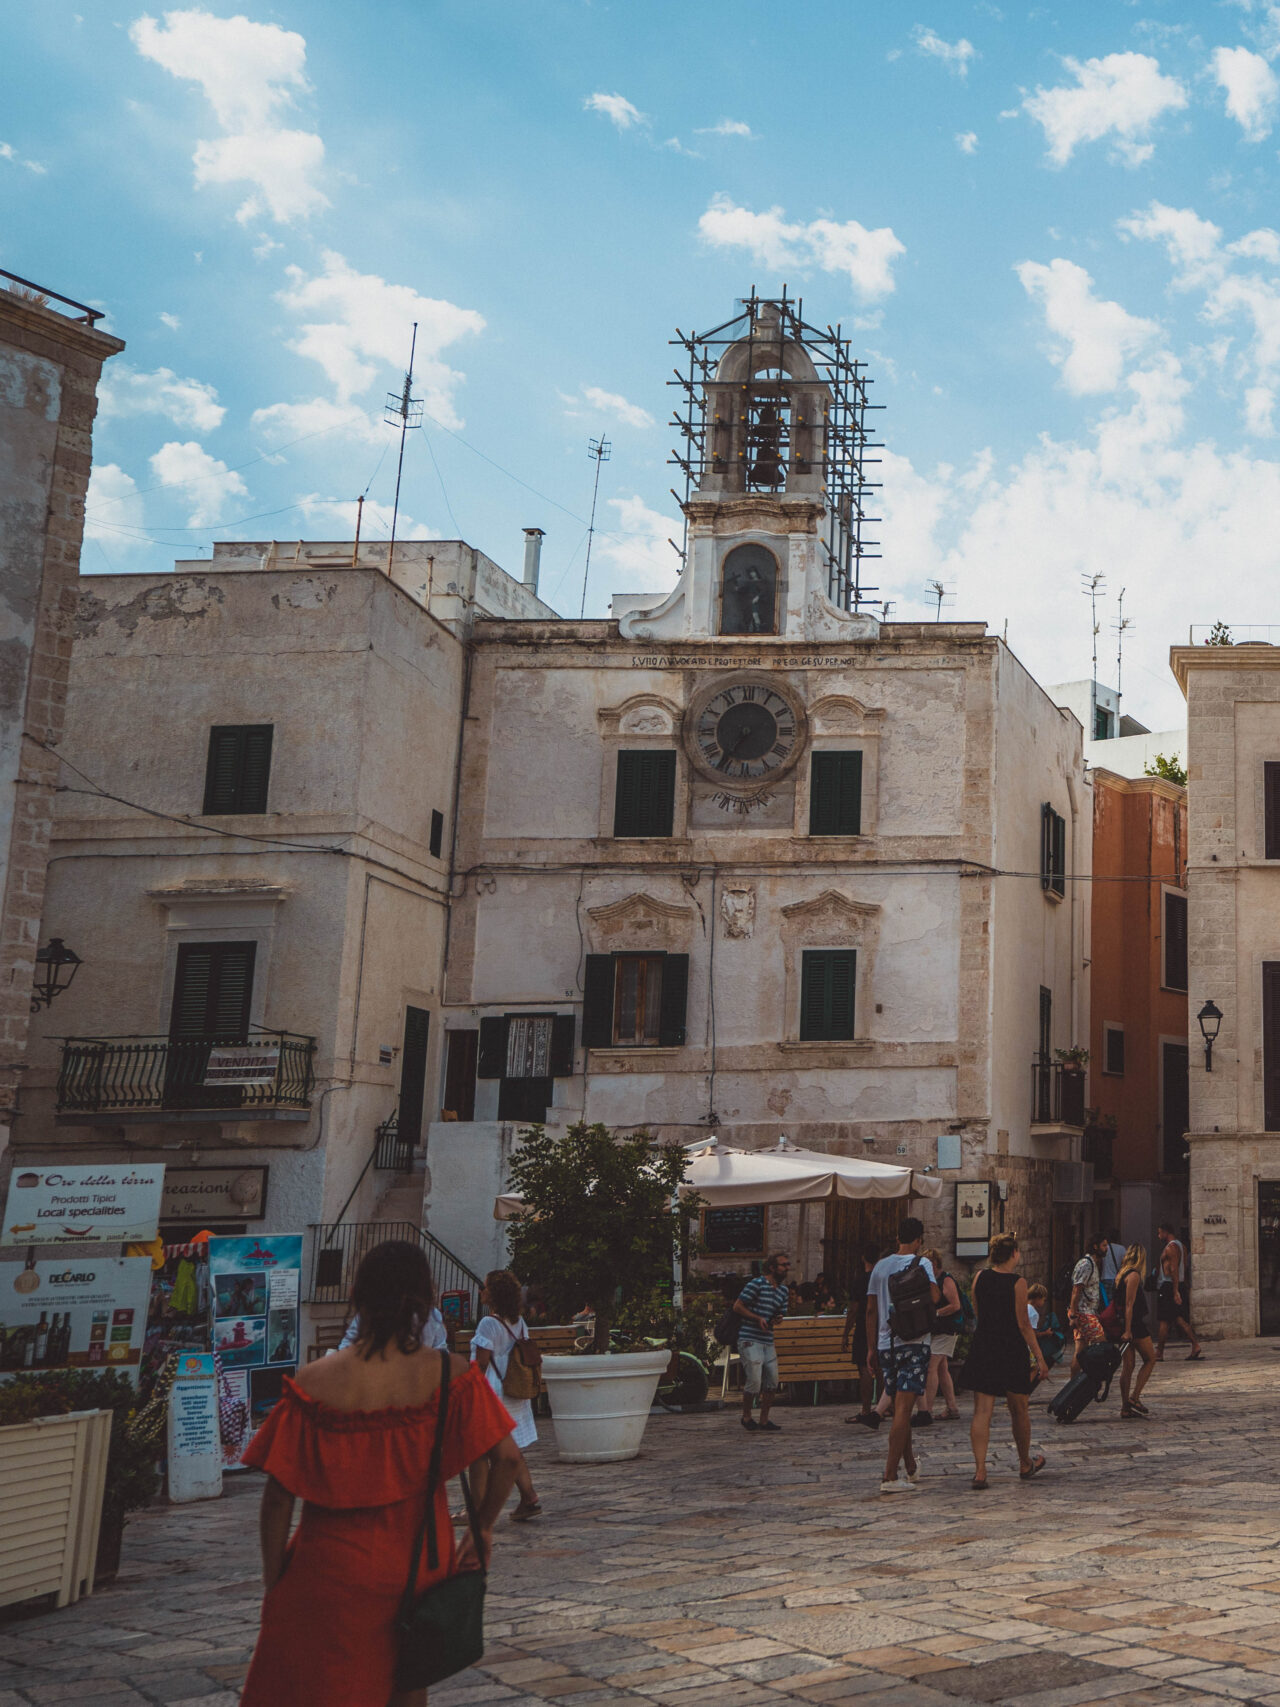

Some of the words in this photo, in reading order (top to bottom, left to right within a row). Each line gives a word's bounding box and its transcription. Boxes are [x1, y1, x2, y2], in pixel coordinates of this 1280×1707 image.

[218, 1057, 267, 1067] VENDITA
[897, 1146, 906, 1154] 59
[45, 1174, 76, 1187] Oro
[80, 1175, 117, 1186] della
[163, 1178, 232, 1196] reazioni
[51, 1194, 89, 1204] Prodotti
[93, 1193, 116, 1204] Tipici
[37, 1207, 66, 1218] Local
[68, 1205, 126, 1219] specialities
[1203, 1217, 1228, 1226] MAMA
